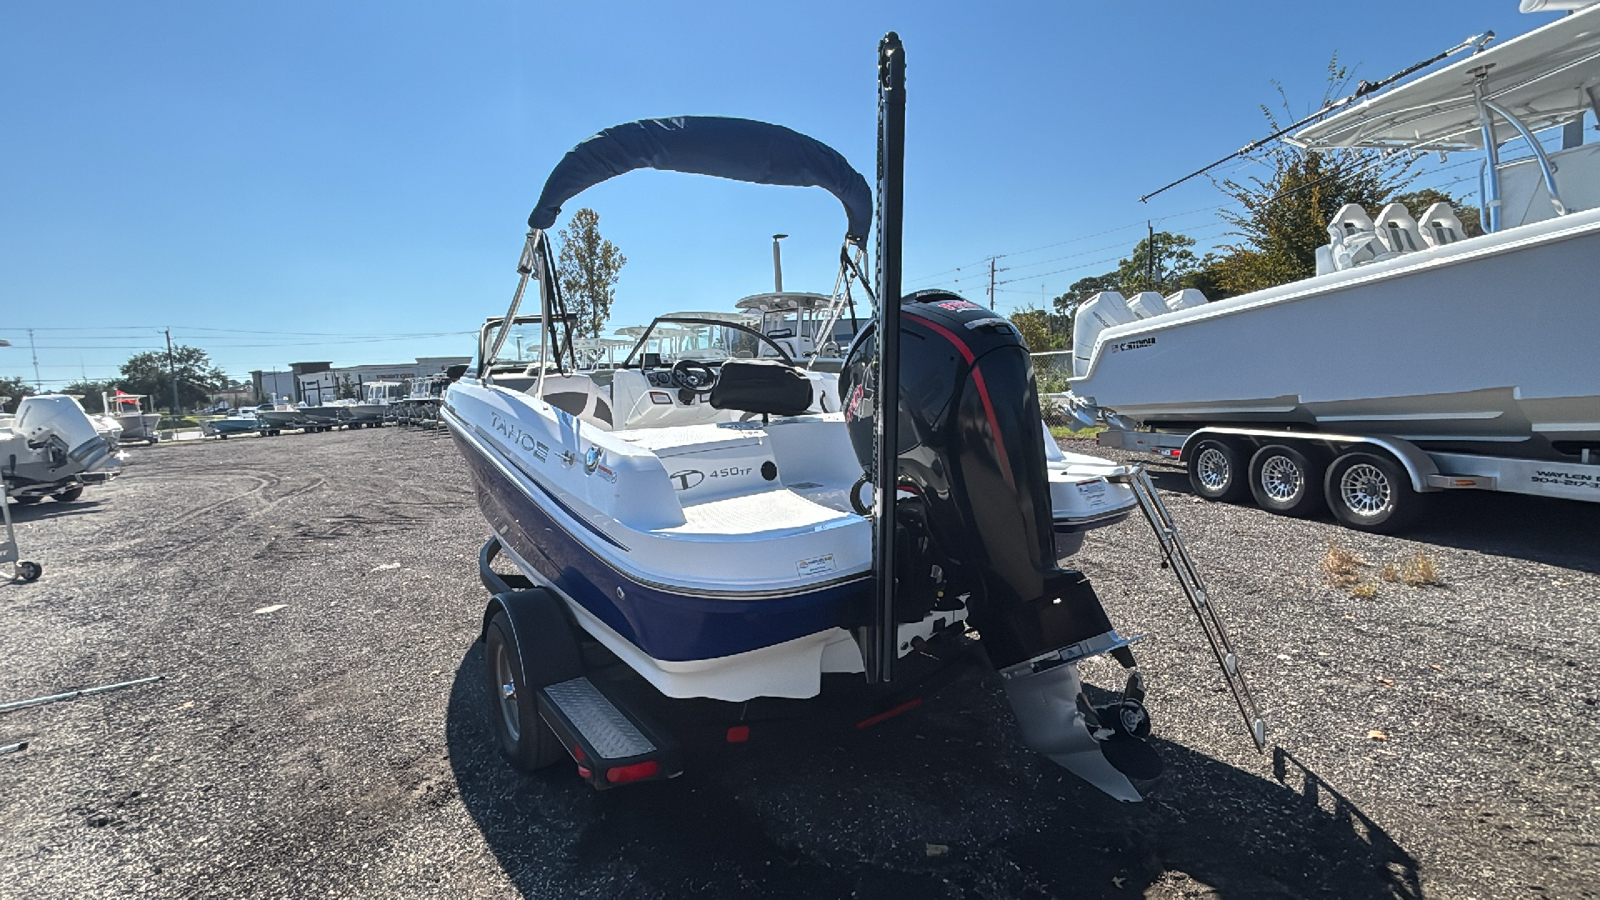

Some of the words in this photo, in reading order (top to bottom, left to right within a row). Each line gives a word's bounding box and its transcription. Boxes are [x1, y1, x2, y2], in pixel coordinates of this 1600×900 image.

[491, 411, 550, 464] TAHOE
[1536, 470, 1592, 481] WAYLEN
[1531, 476, 1600, 488] 904-217-3
